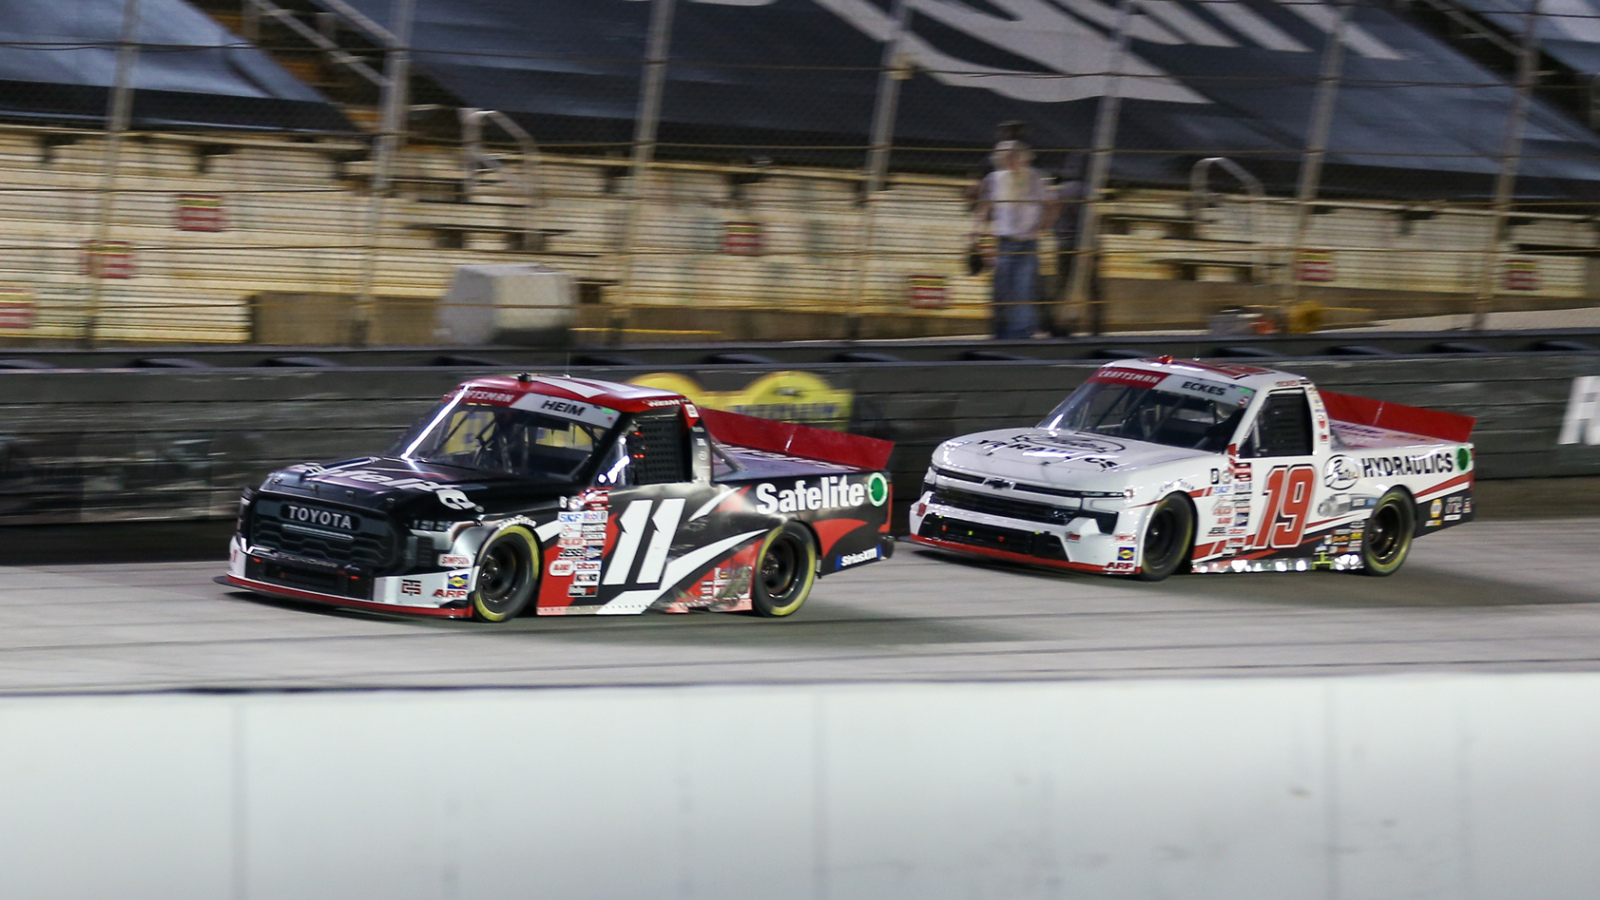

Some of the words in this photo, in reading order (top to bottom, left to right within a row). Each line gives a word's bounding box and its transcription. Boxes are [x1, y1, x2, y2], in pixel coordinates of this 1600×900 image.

[1098, 370, 1159, 384] CRAFTSMAN
[1181, 381, 1227, 396] ECKES
[540, 399, 587, 417] HEIM
[1361, 452, 1454, 478] HYDRAULICS
[755, 474, 866, 516] Safelite
[1252, 463, 1317, 550] 19
[288, 504, 353, 530] TOYOTA
[559, 513, 583, 523] SKF
[602, 497, 686, 586] 11
[442, 556, 470, 565] SIMPSON
[432, 588, 468, 598] ARP
